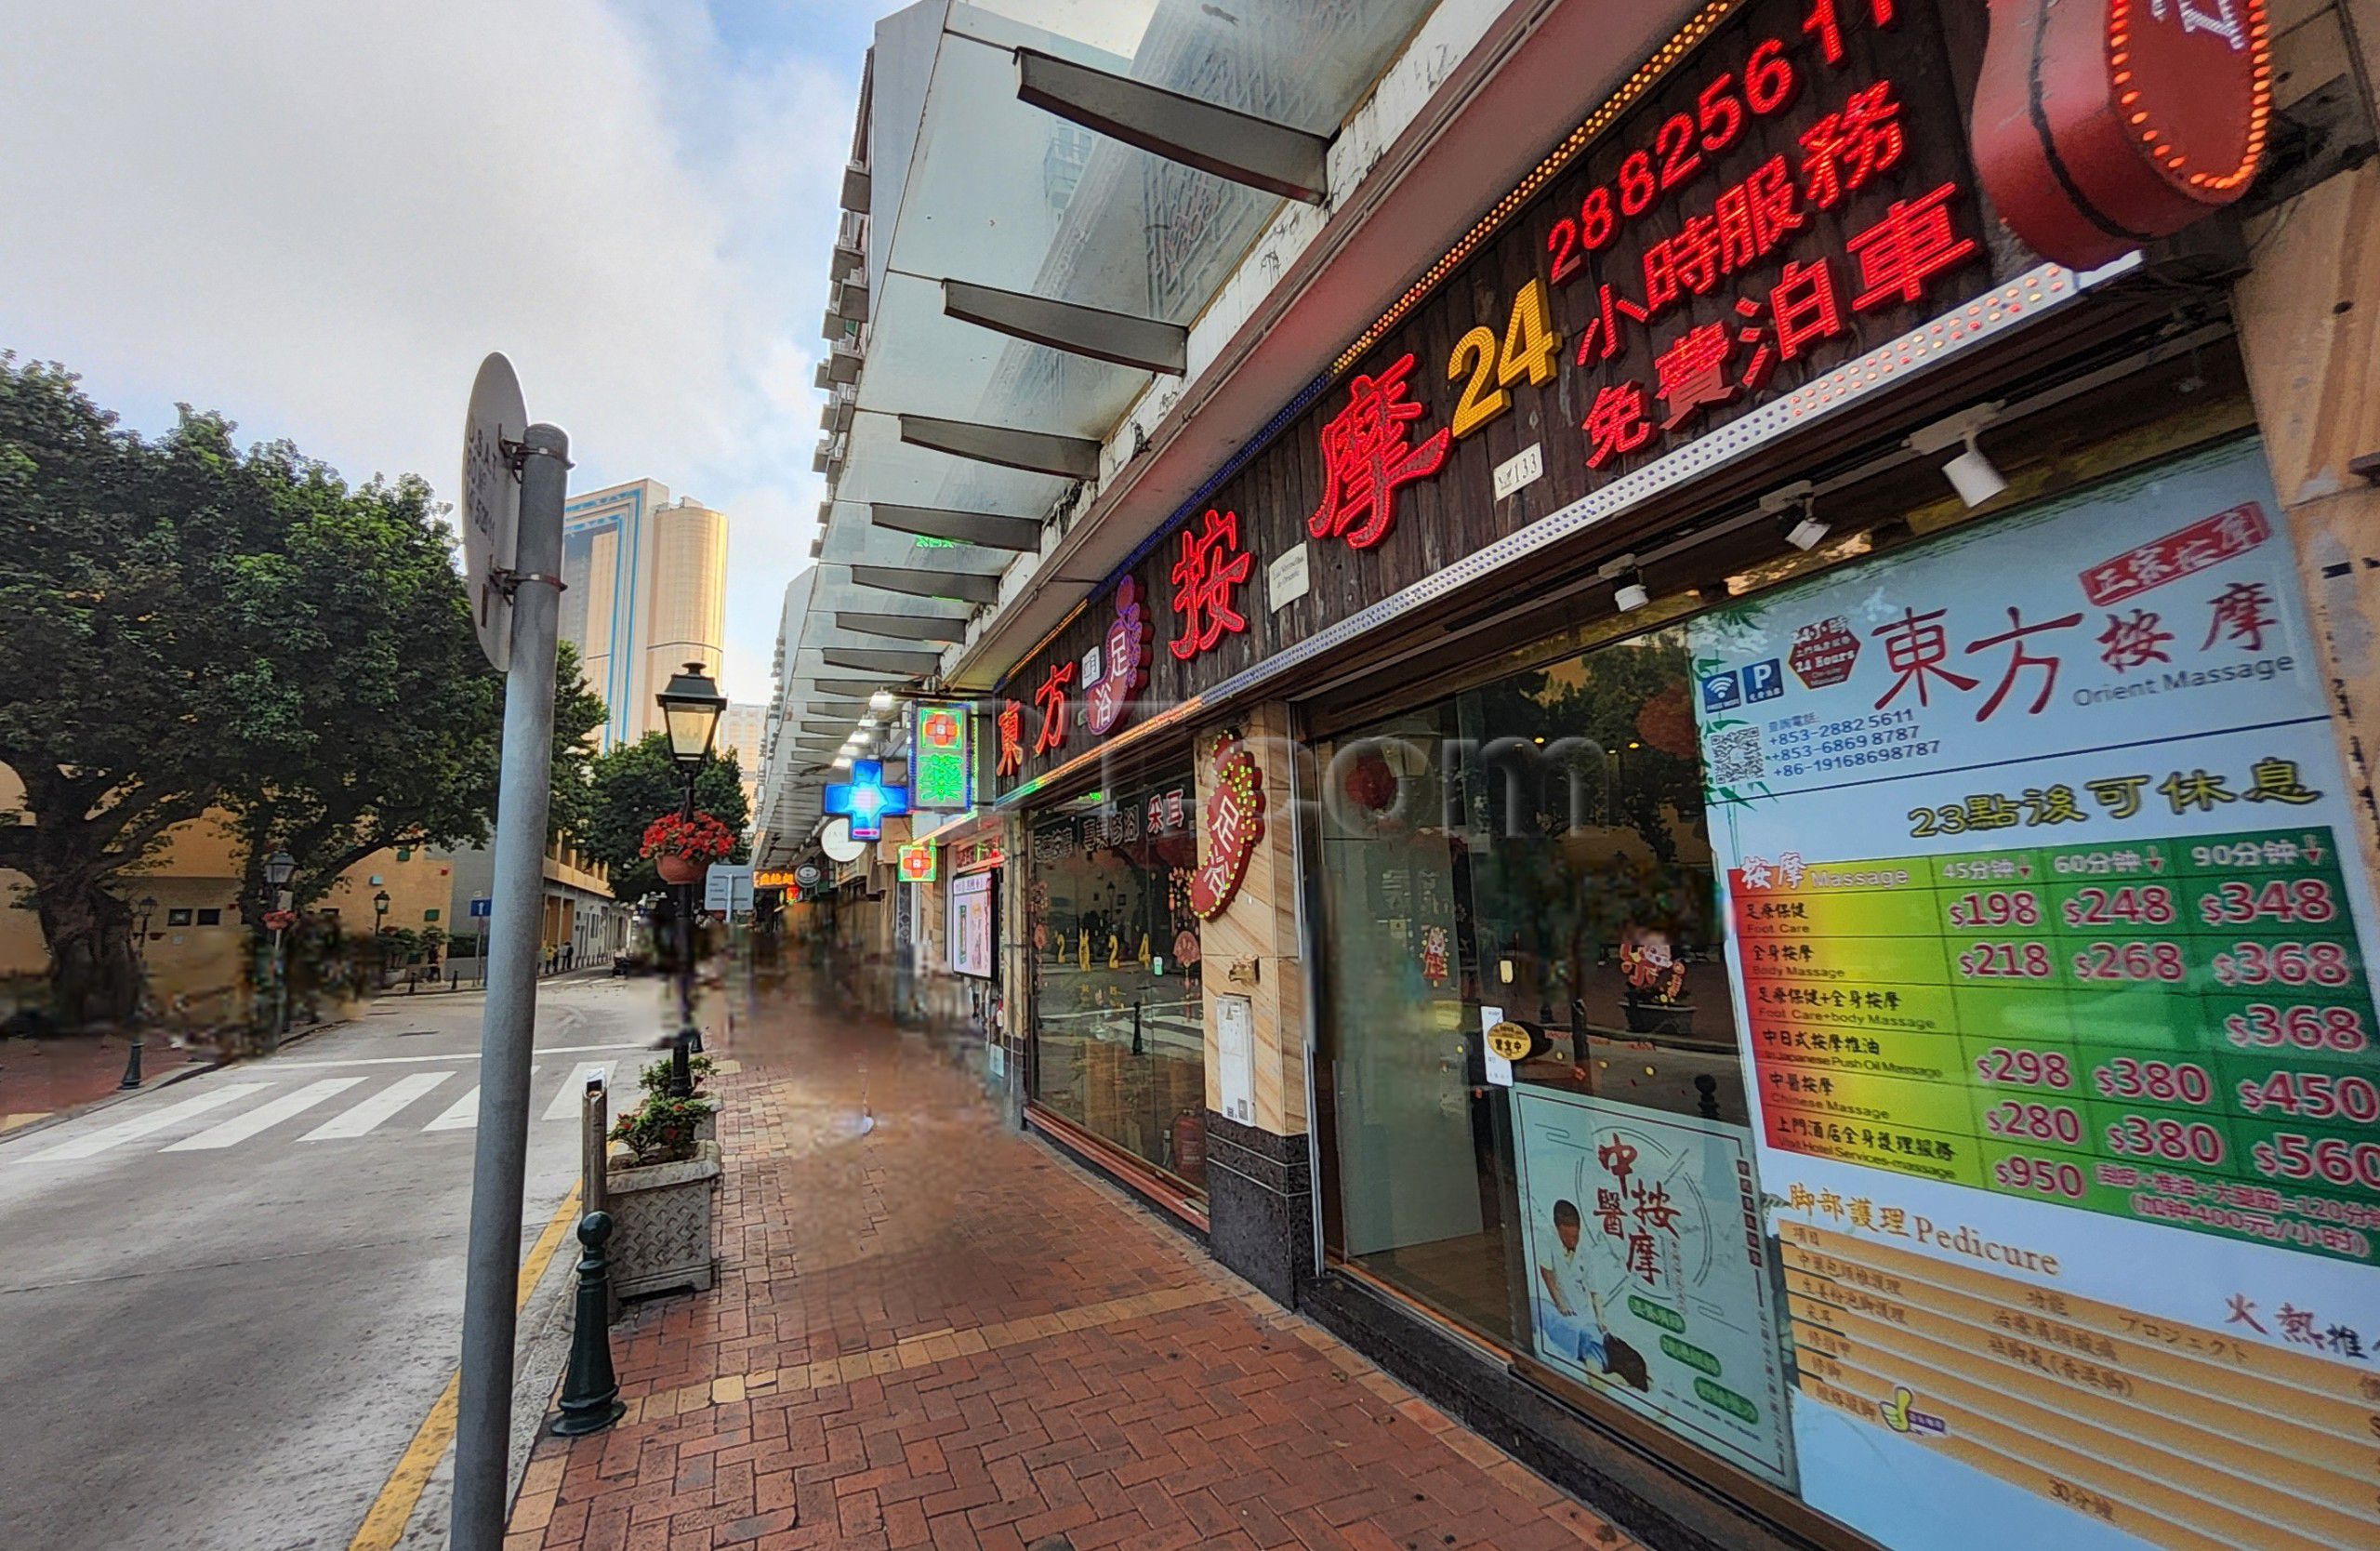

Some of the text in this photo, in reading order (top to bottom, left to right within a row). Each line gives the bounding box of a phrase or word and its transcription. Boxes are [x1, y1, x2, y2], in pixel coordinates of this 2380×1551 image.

[1578, 80, 1904, 366] 小時服務
[1583, 182, 1977, 469] 免費泊車
[1448, 278, 1563, 438] 24
[1514, 453, 1538, 484] 133
[998, 353, 1451, 777] 東方 按摩
[1871, 582, 2278, 723] 東方 按摩
[1094, 630, 1130, 729] 足浴
[1753, 664, 1772, 690] P
[2072, 655, 2294, 707] Orient Massage
[1770, 709, 1914, 746] +853-2882 5611
[1772, 725, 1920, 762] +853-6869 8787
[919, 754, 962, 802] 藥
[1774, 740, 1941, 777] +86-19168698787
[1908, 756, 2322, 838] 23點後可休息
[1740, 852, 1909, 890] 按摩 Massage
[1949, 891, 2040, 929] $198
[2063, 886, 2175, 928] $248
[2199, 879, 2335, 926] $348
[1778, 924, 1810, 934] Care
[1752, 944, 1815, 963] 全身按摩
[1753, 965, 1845, 979] Body Massage
[1959, 941, 2051, 979] $218
[2074, 941, 2186, 983] $268
[2212, 941, 2351, 988] $368
[1868, 1014, 1936, 1030] Massage
[2224, 1002, 2368, 1053] $368
[1831, 1055, 1863, 1069] Push
[1881, 1061, 1943, 1079] Massage
[1976, 1047, 2074, 1090] $298
[2094, 1056, 2213, 1105] $380
[1827, 1100, 1890, 1120] Massage
[2236, 1070, 2380, 1123] $450
[1986, 1099, 2083, 1146] $280
[2106, 1114, 2225, 1165] $380
[1993, 1154, 2085, 1200] $950
[2251, 1133, 2380, 1191] $560
[1593, 1132, 1638, 1240] 中醫
[1627, 1177, 1682, 1286] 按摩
[1912, 1213, 2060, 1277] Pedicure
[2224, 1292, 2380, 1360] 火熱推
